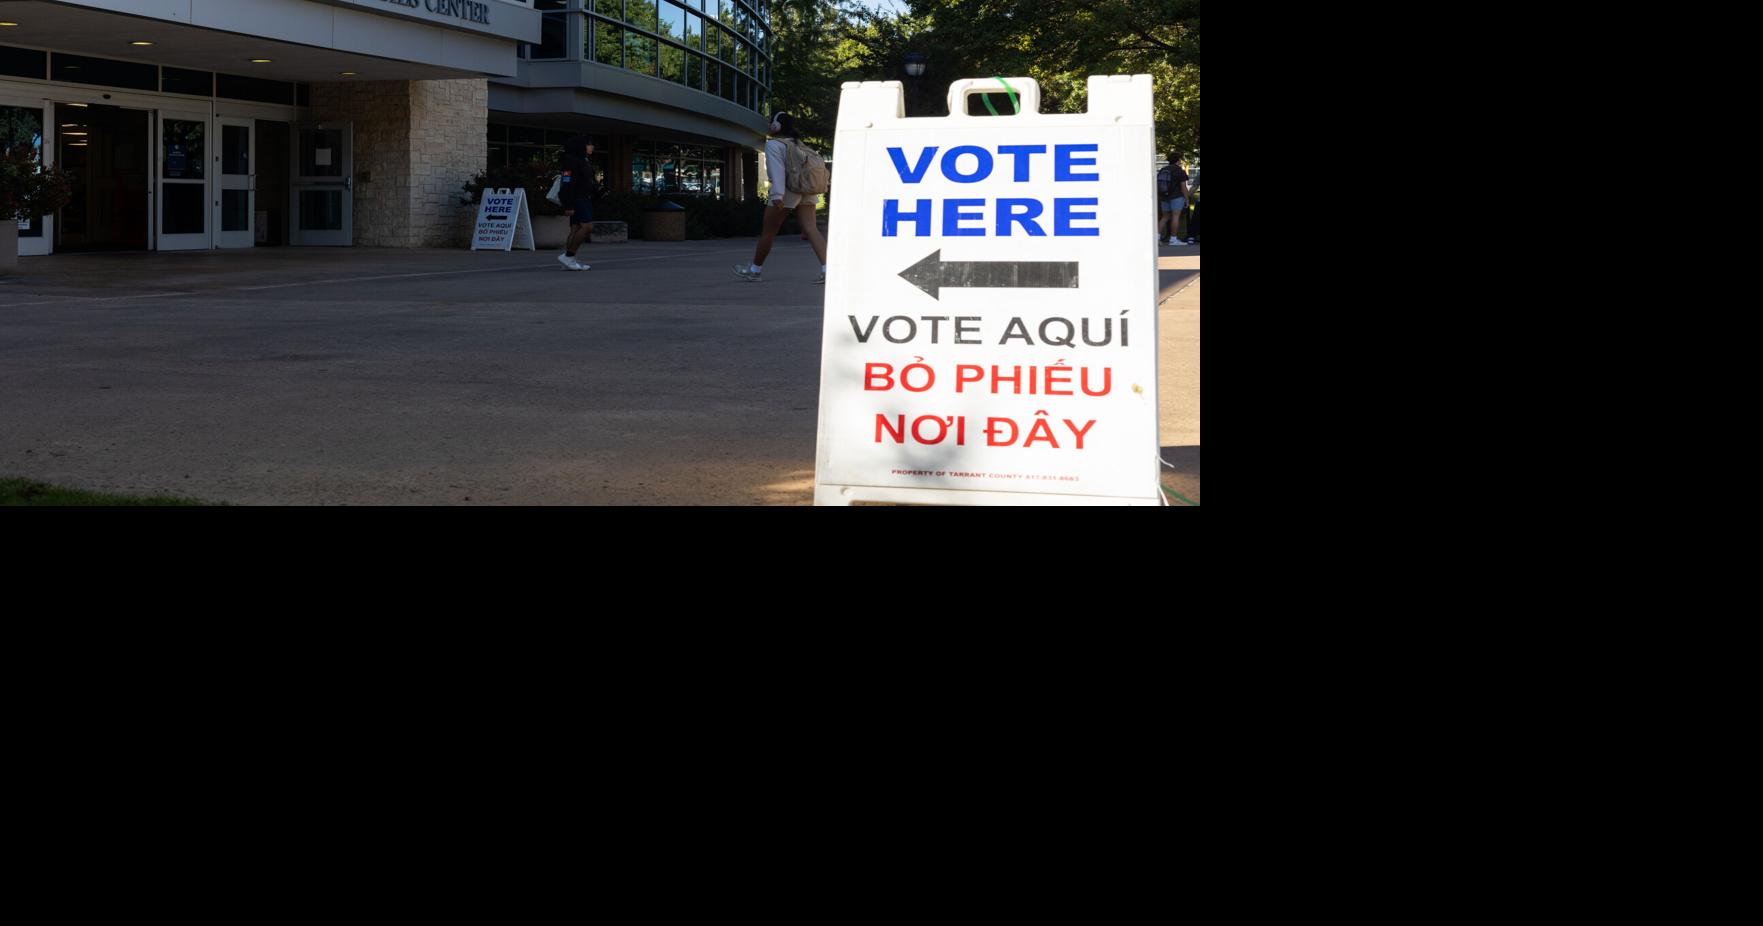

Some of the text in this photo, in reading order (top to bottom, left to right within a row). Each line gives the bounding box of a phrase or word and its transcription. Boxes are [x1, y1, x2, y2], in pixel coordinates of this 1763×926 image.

[425, 0, 490, 24] CENTER
[886, 143, 1099, 184] VOTE
[881, 197, 1100, 237] HERE
[848, 310, 1129, 349] VOTE AQUÍ
[864, 356, 1112, 397] BỎ PHIẾU
[874, 410, 1096, 450] NƠI ĐÂY
[891, 469, 934, 477] PROPERTY
